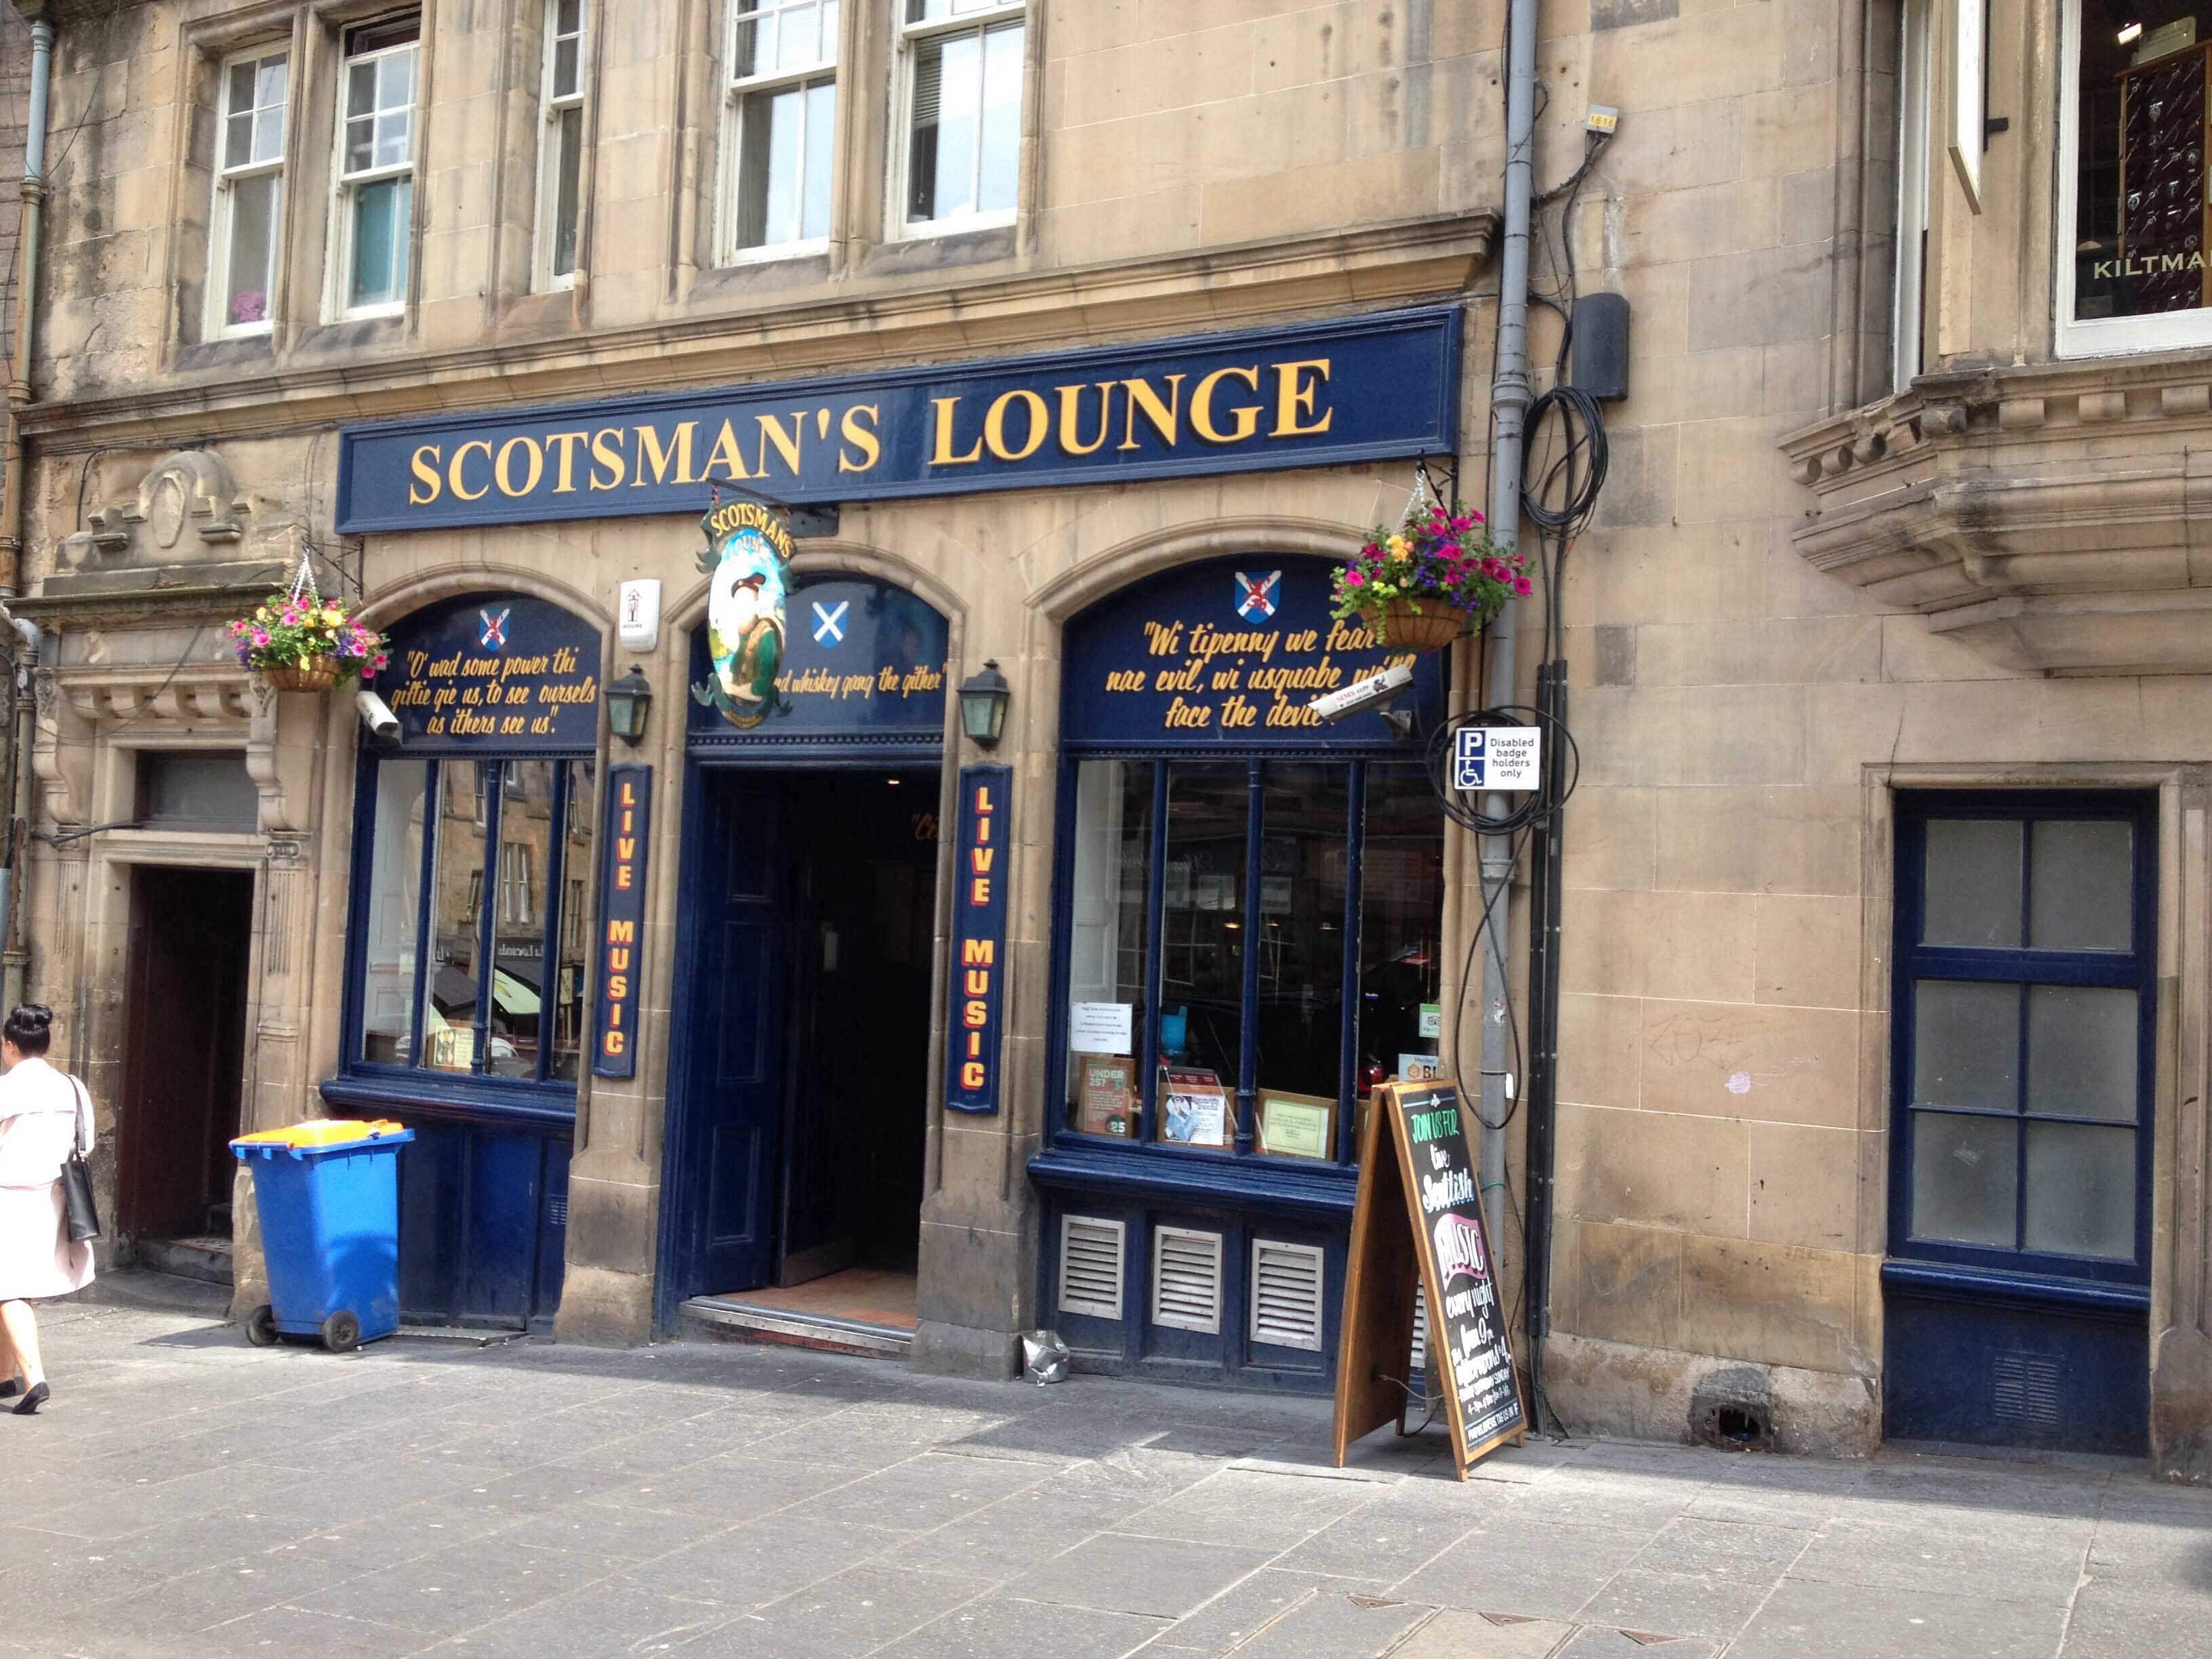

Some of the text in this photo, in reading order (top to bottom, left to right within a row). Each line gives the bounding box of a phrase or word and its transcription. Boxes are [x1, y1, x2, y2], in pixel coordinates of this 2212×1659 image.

[2093, 249, 2212, 279] KILTMA
[409, 359, 1333, 505] SCOTSMAN'S LOUNGE
[711, 504, 794, 558] SCOTSMANS
[1189, 622, 1280, 663] tipenny
[1285, 629, 1318, 651] we
[1325, 619, 1376, 651] fear
[428, 651, 463, 676] wad
[461, 658, 500, 676] some
[500, 655, 549, 683] power
[773, 669, 792, 693] nd
[878, 665, 900, 691] the
[1105, 670, 1147, 691] nae
[1155, 658, 1205, 693] evil,
[1211, 658, 1246, 690] wi
[1247, 655, 1343, 701] usquabe
[390, 679, 432, 713] giftie
[434, 678, 457, 713] gie
[487, 678, 503, 703] to
[504, 686, 531, 704] see
[538, 676, 596, 703] oursels
[426, 716, 446, 735] as
[450, 708, 496, 735] ithers
[499, 716, 525, 734] see
[1164, 696, 1212, 728] face
[1221, 695, 1258, 726] the
[1465, 733, 1483, 756] P
[1490, 739, 1534, 747] Disabled
[1496, 749, 1527, 758] badge
[1492, 759, 1530, 767] holders
[1500, 769, 1521, 779] only
[604, 783, 635, 1056] LIVE MUSIC
[960, 786, 995, 1091] LIVE MUSIC
[1089, 1069, 1124, 1080] UNDER
[1111, 1121, 1126, 1133] 25
[1411, 1108, 1460, 1143] JOIN US FOR
[1430, 1144, 1450, 1170] live
[1422, 1168, 1475, 1213] Scottish
[1471, 1276, 1495, 1319] night
